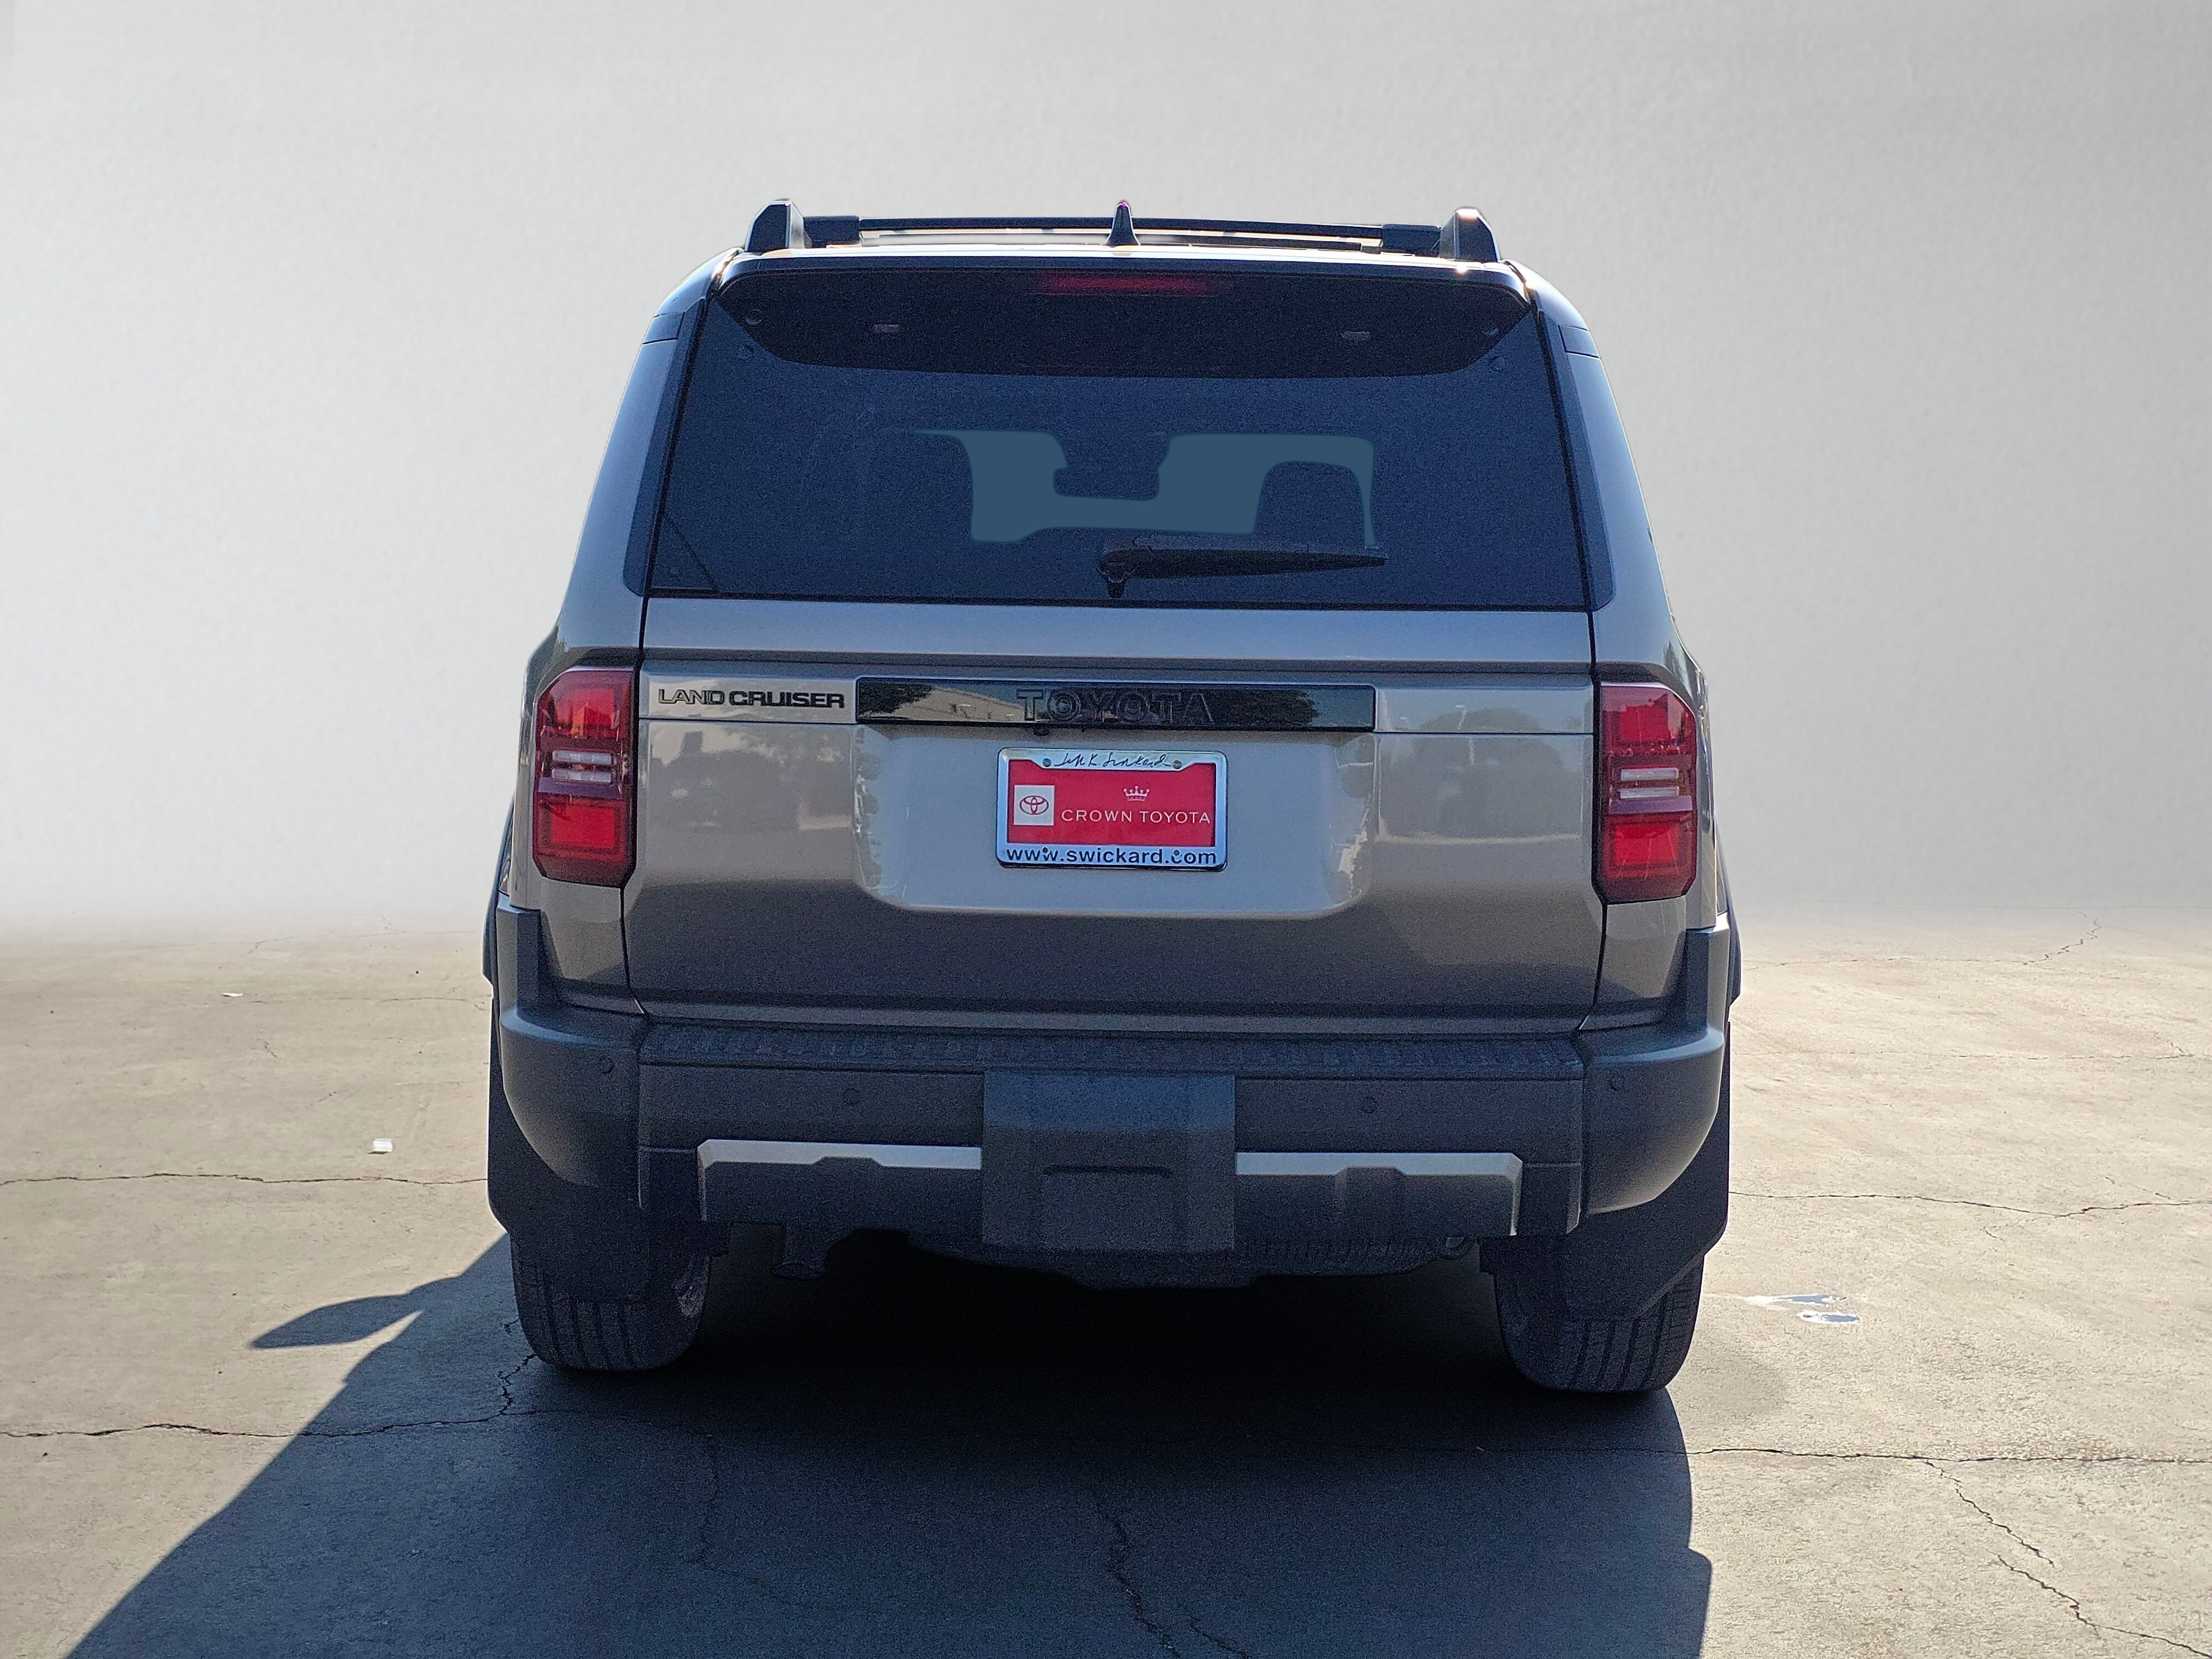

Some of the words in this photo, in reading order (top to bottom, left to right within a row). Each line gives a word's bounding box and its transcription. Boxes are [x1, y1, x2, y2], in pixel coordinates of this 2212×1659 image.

[659, 688, 725, 706] LAND
[729, 690, 845, 708] CRUISER
[1016, 689, 1214, 724] TOYOTA
[1061, 809, 1132, 823] CROWN
[1139, 811, 1211, 824] TOYOTA
[1006, 847, 1217, 864] www.swickard.com
